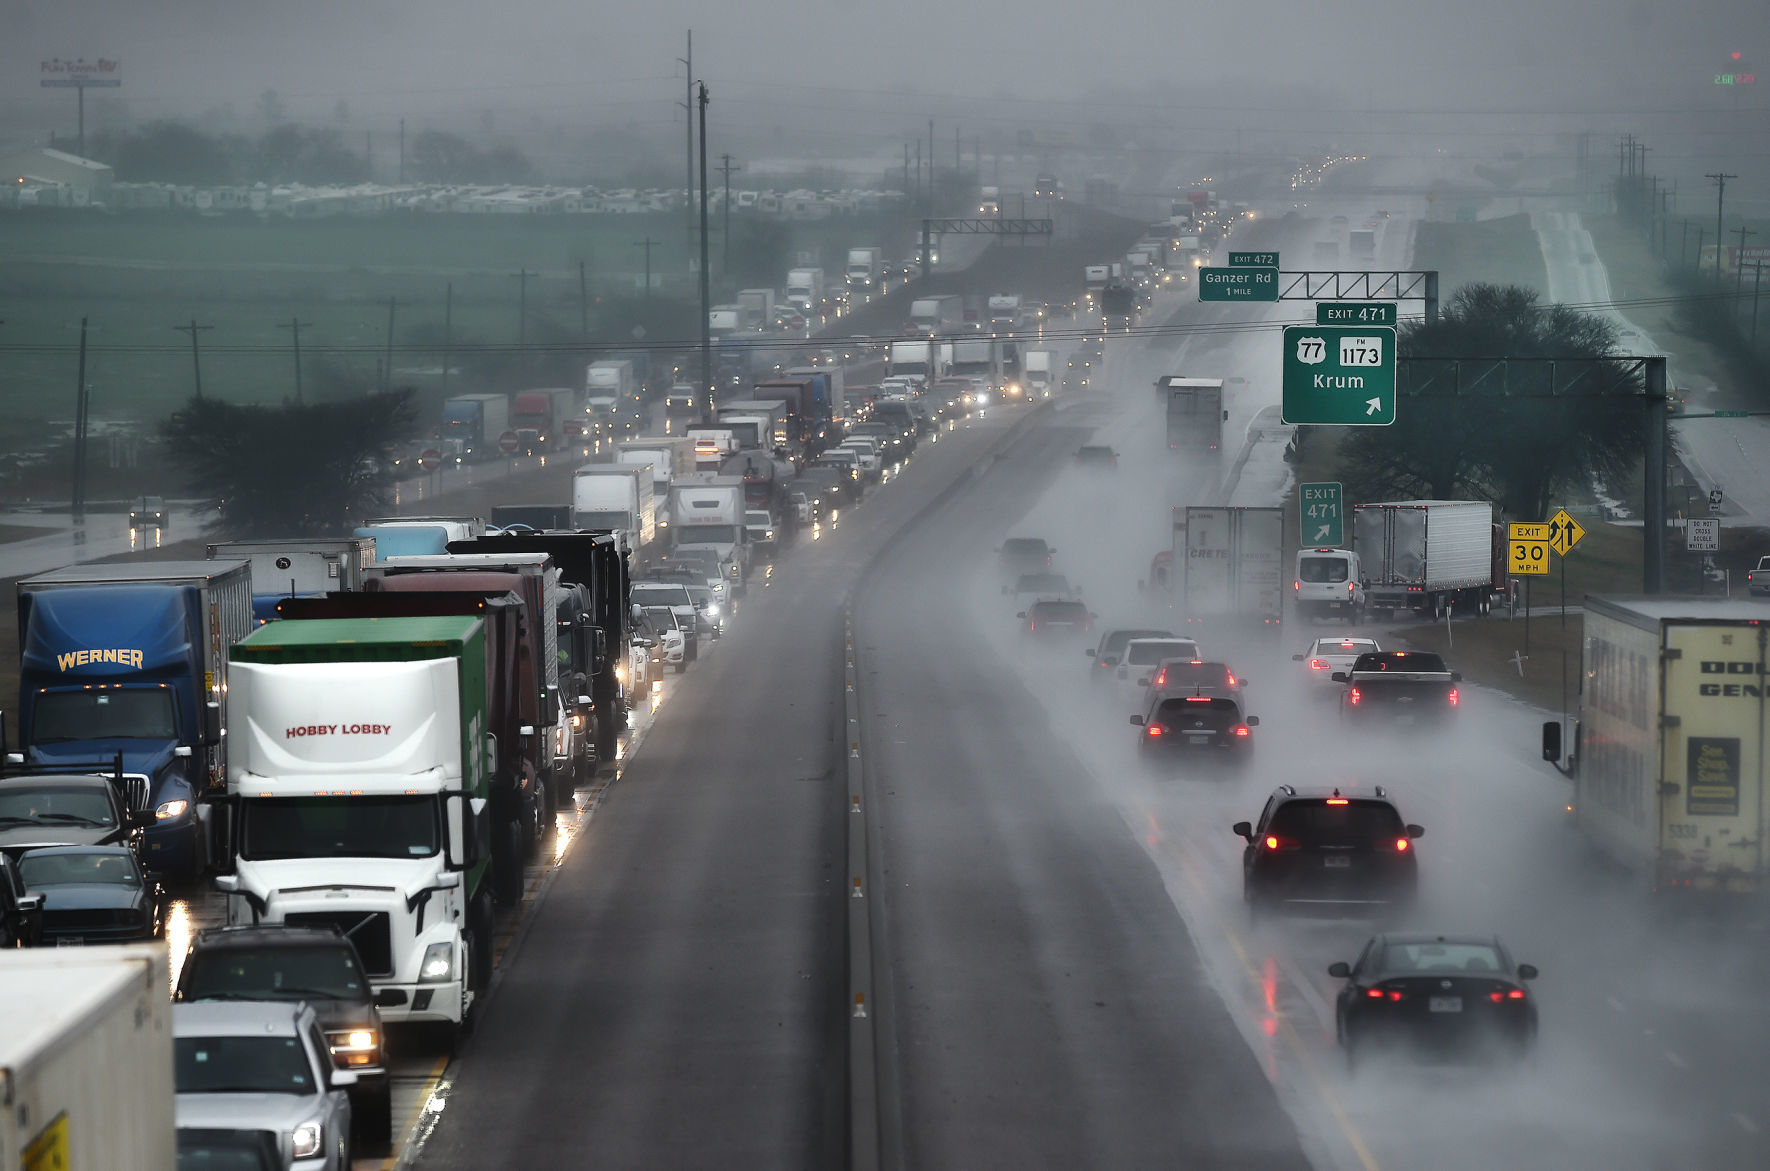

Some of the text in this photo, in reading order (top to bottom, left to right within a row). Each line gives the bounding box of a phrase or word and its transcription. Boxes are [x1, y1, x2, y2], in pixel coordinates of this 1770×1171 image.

[1254, 255, 1273, 264] 472
[1205, 273, 1271, 283] Ganzer Rd
[1226, 287, 1231, 296] 1
[1328, 307, 1386, 321] EXIT 471
[1301, 342, 1322, 358] 77
[1342, 348, 1379, 364] 1173
[1313, 374, 1364, 388] Krum
[1305, 489, 1336, 499] EXIT
[1307, 503, 1336, 519] 471
[1517, 527, 1541, 537] EXIT
[1190, 548, 1229, 559] CRETE
[1514, 545, 1543, 561] 30
[1518, 564, 1539, 572] MPH
[57, 648, 144, 673] WERNER
[1699, 683, 1770, 698] GEN
[286, 724, 391, 739] HOBBY LOBBY
